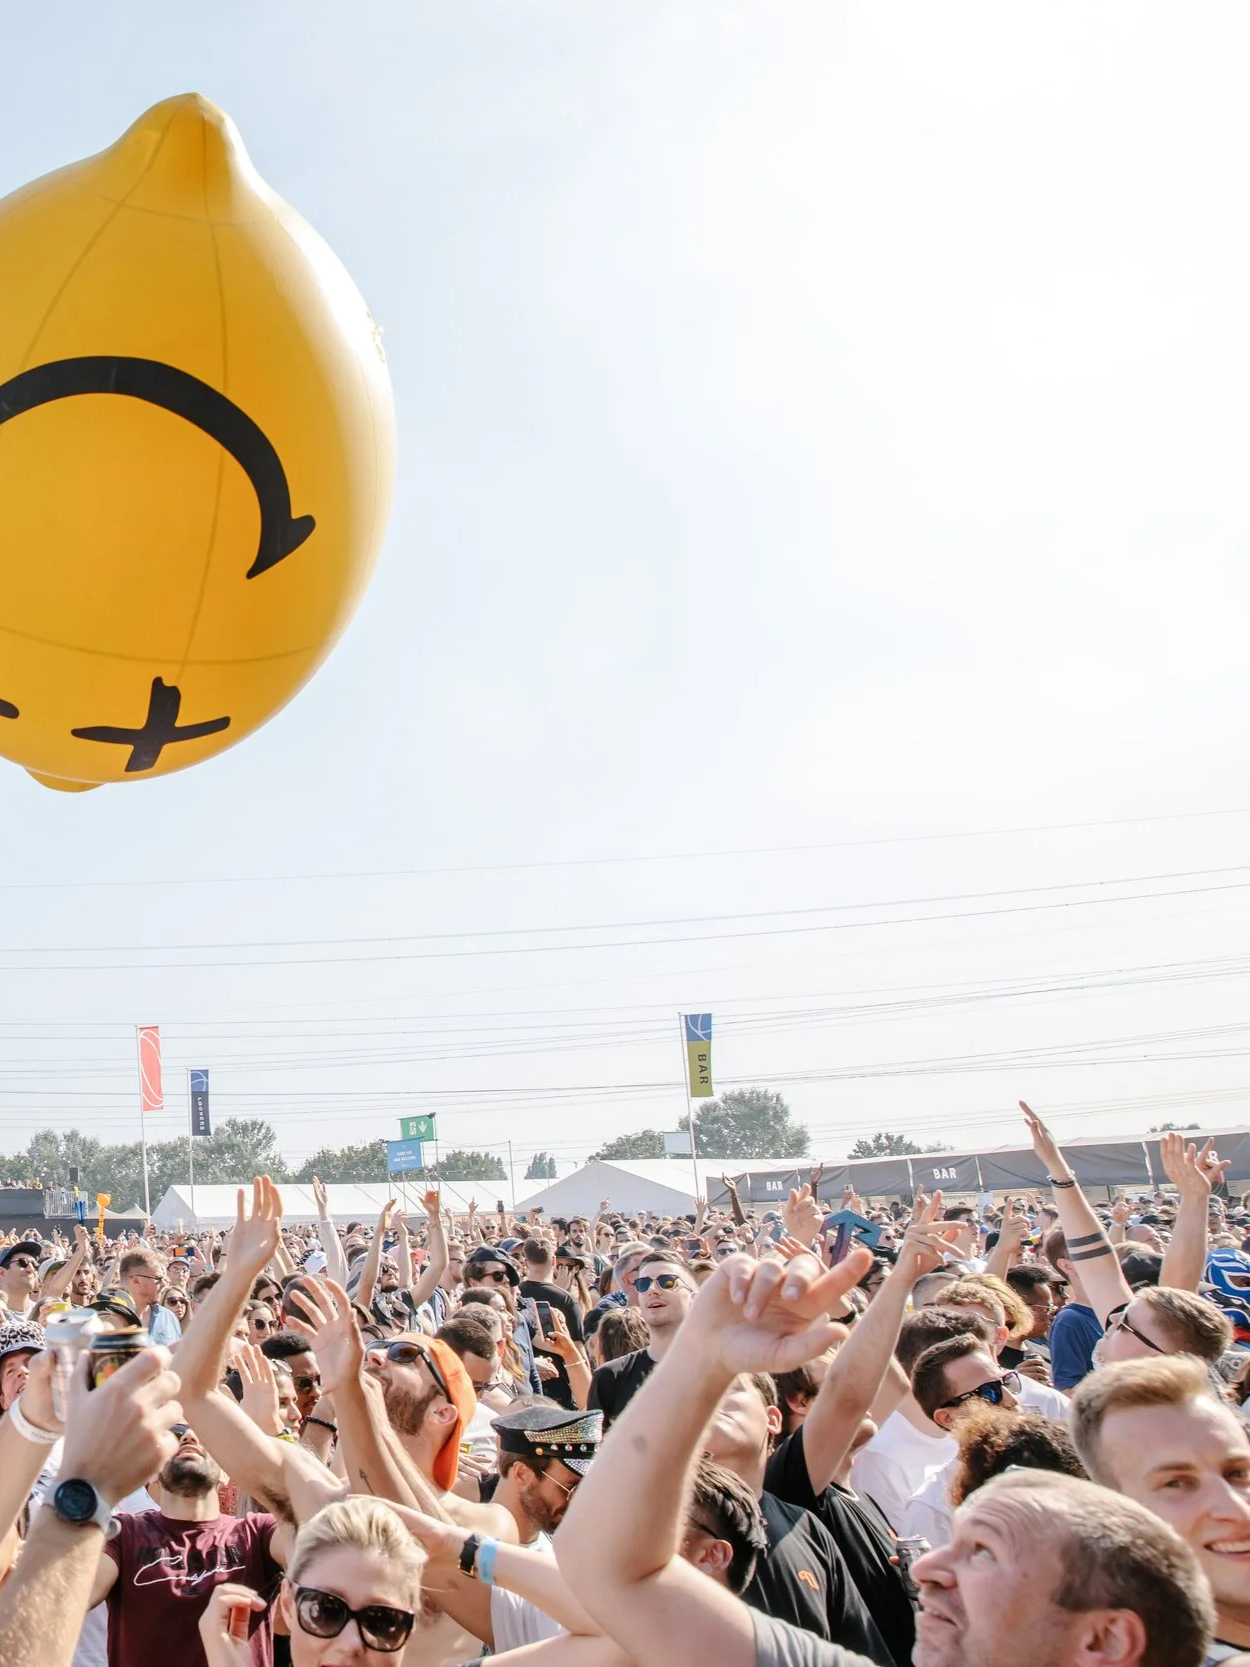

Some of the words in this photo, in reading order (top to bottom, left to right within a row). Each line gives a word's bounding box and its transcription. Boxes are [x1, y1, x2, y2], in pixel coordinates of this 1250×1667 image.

[698, 1054, 708, 1084] BAR
[197, 1097, 206, 1131] LOCKERS
[932, 1167, 957, 1179] BAR
[765, 1181, 783, 1191] BAR
